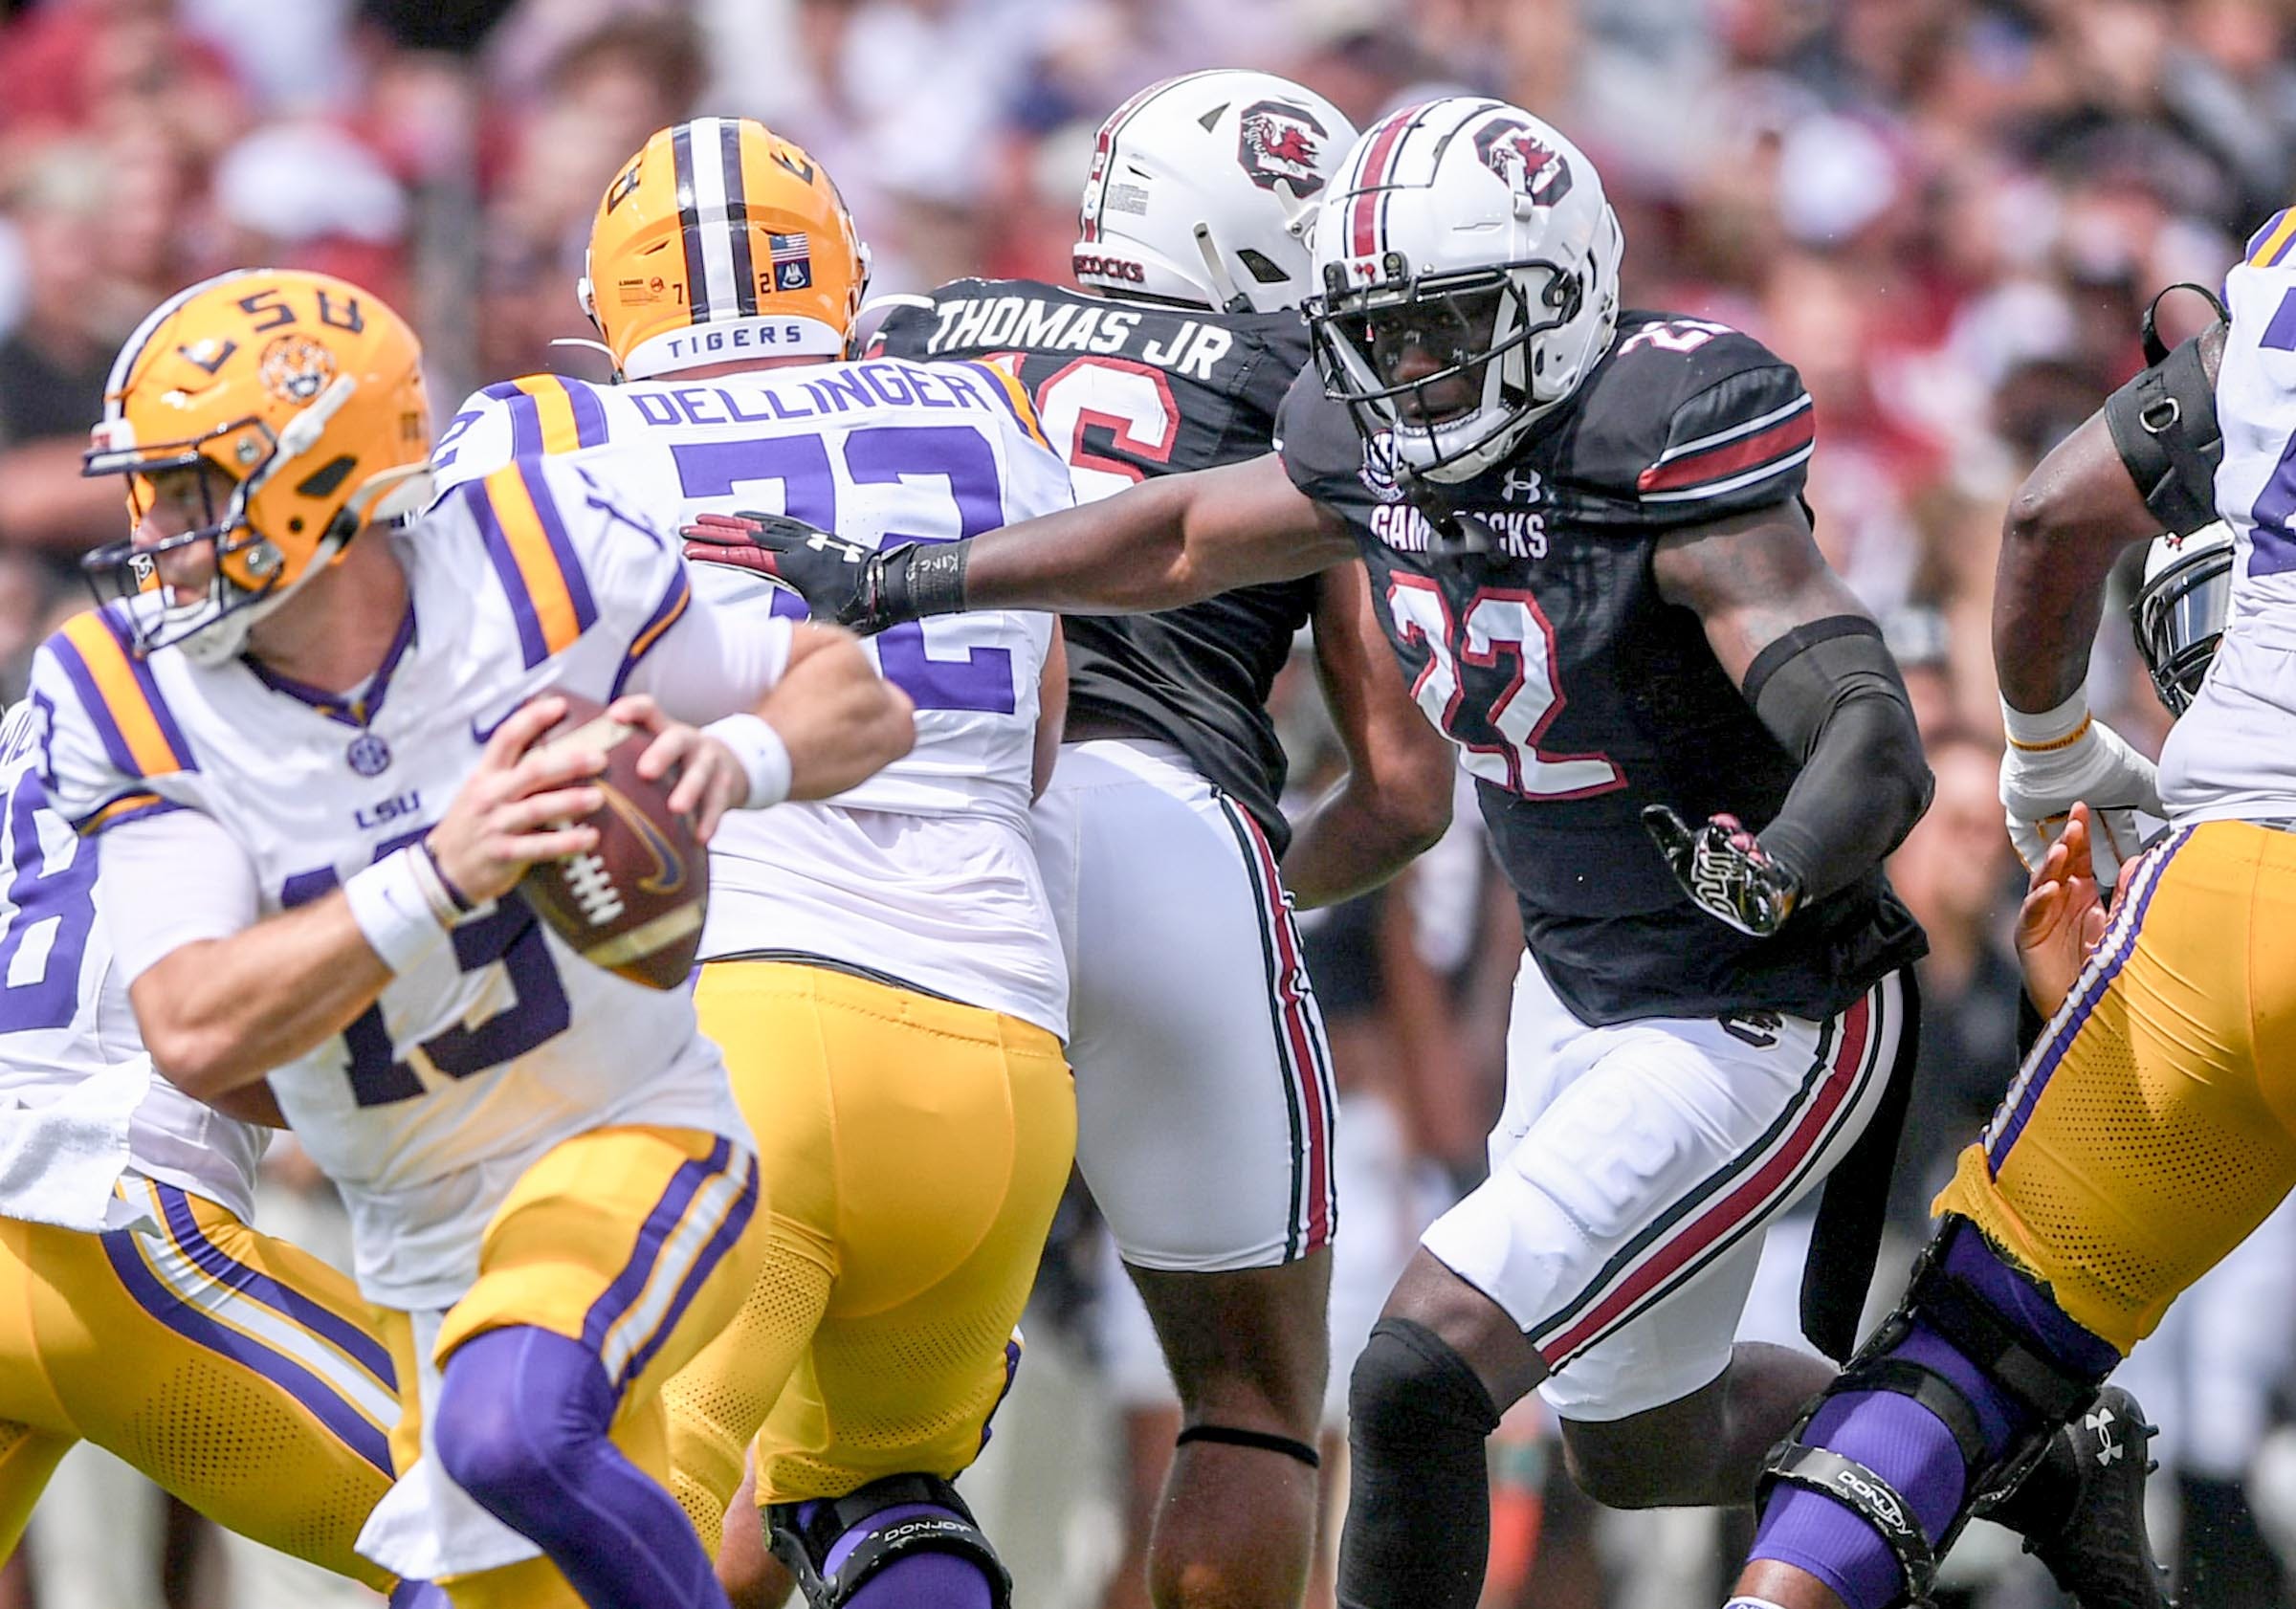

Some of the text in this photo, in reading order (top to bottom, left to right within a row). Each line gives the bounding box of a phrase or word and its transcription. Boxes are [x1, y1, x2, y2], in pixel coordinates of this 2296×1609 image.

[672, 283, 684, 305] 7
[759, 273, 772, 295] 2
[667, 324, 803, 359] TIGERS
[926, 297, 1234, 382] THOMAS JR
[629, 364, 982, 427] DELLINGER
[1370, 503, 1551, 560] GAMCKS
[670, 426, 1016, 716] 72
[1386, 569, 1628, 802] 22
[355, 790, 420, 830] LSU
[0, 764, 100, 1034] 8
[884, 1520, 973, 1542] DONJOY
[1837, 1469, 1914, 1535] DONJOY
